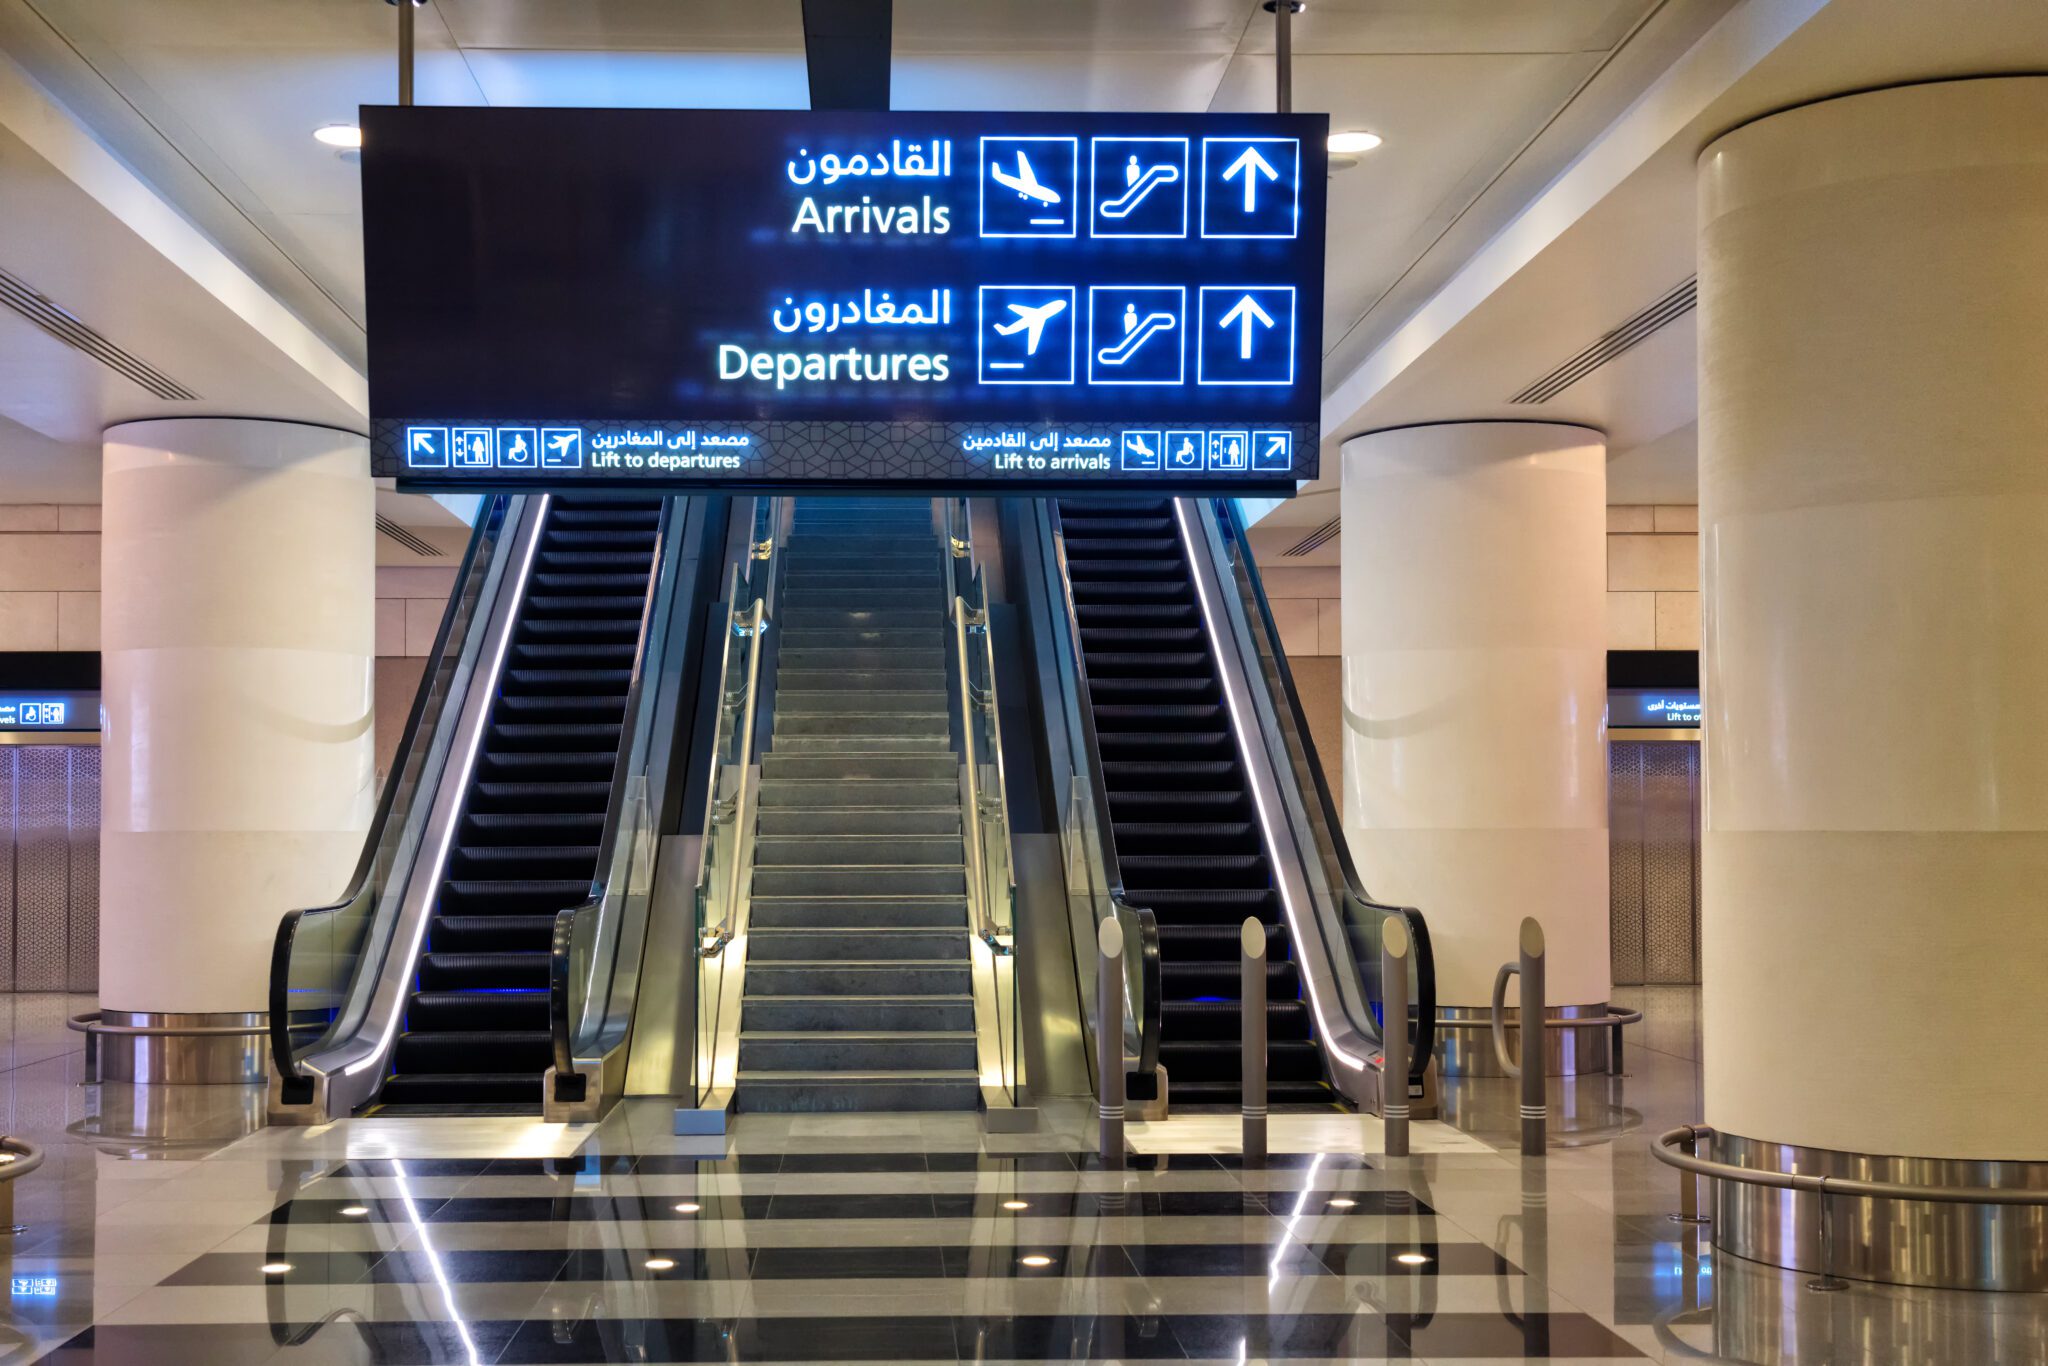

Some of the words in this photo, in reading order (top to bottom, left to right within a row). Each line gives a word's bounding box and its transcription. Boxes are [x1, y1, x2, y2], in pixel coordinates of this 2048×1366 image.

[787, 139, 951, 185] القادمون
[791, 195, 951, 235] Arrivals
[773, 288, 951, 333] المغادرون
[719, 344, 949, 390] Departures
[591, 430, 663, 449] المغادرين
[667, 430, 696, 450] إلى
[700, 435, 750, 447] مصعد
[962, 431, 1026, 451] القادمين
[1030, 431, 1059, 451] إلى
[1063, 437, 1112, 448] مصعد
[591, 451, 621, 468] Lift
[624, 453, 644, 468] to
[647, 451, 741, 471] departures
[995, 453, 1023, 469] Lift
[1027, 455, 1046, 469] to
[1050, 453, 1111, 470] arrivals
[1667, 712, 1682, 721] Lift
[1682, 713, 1692, 721] to
